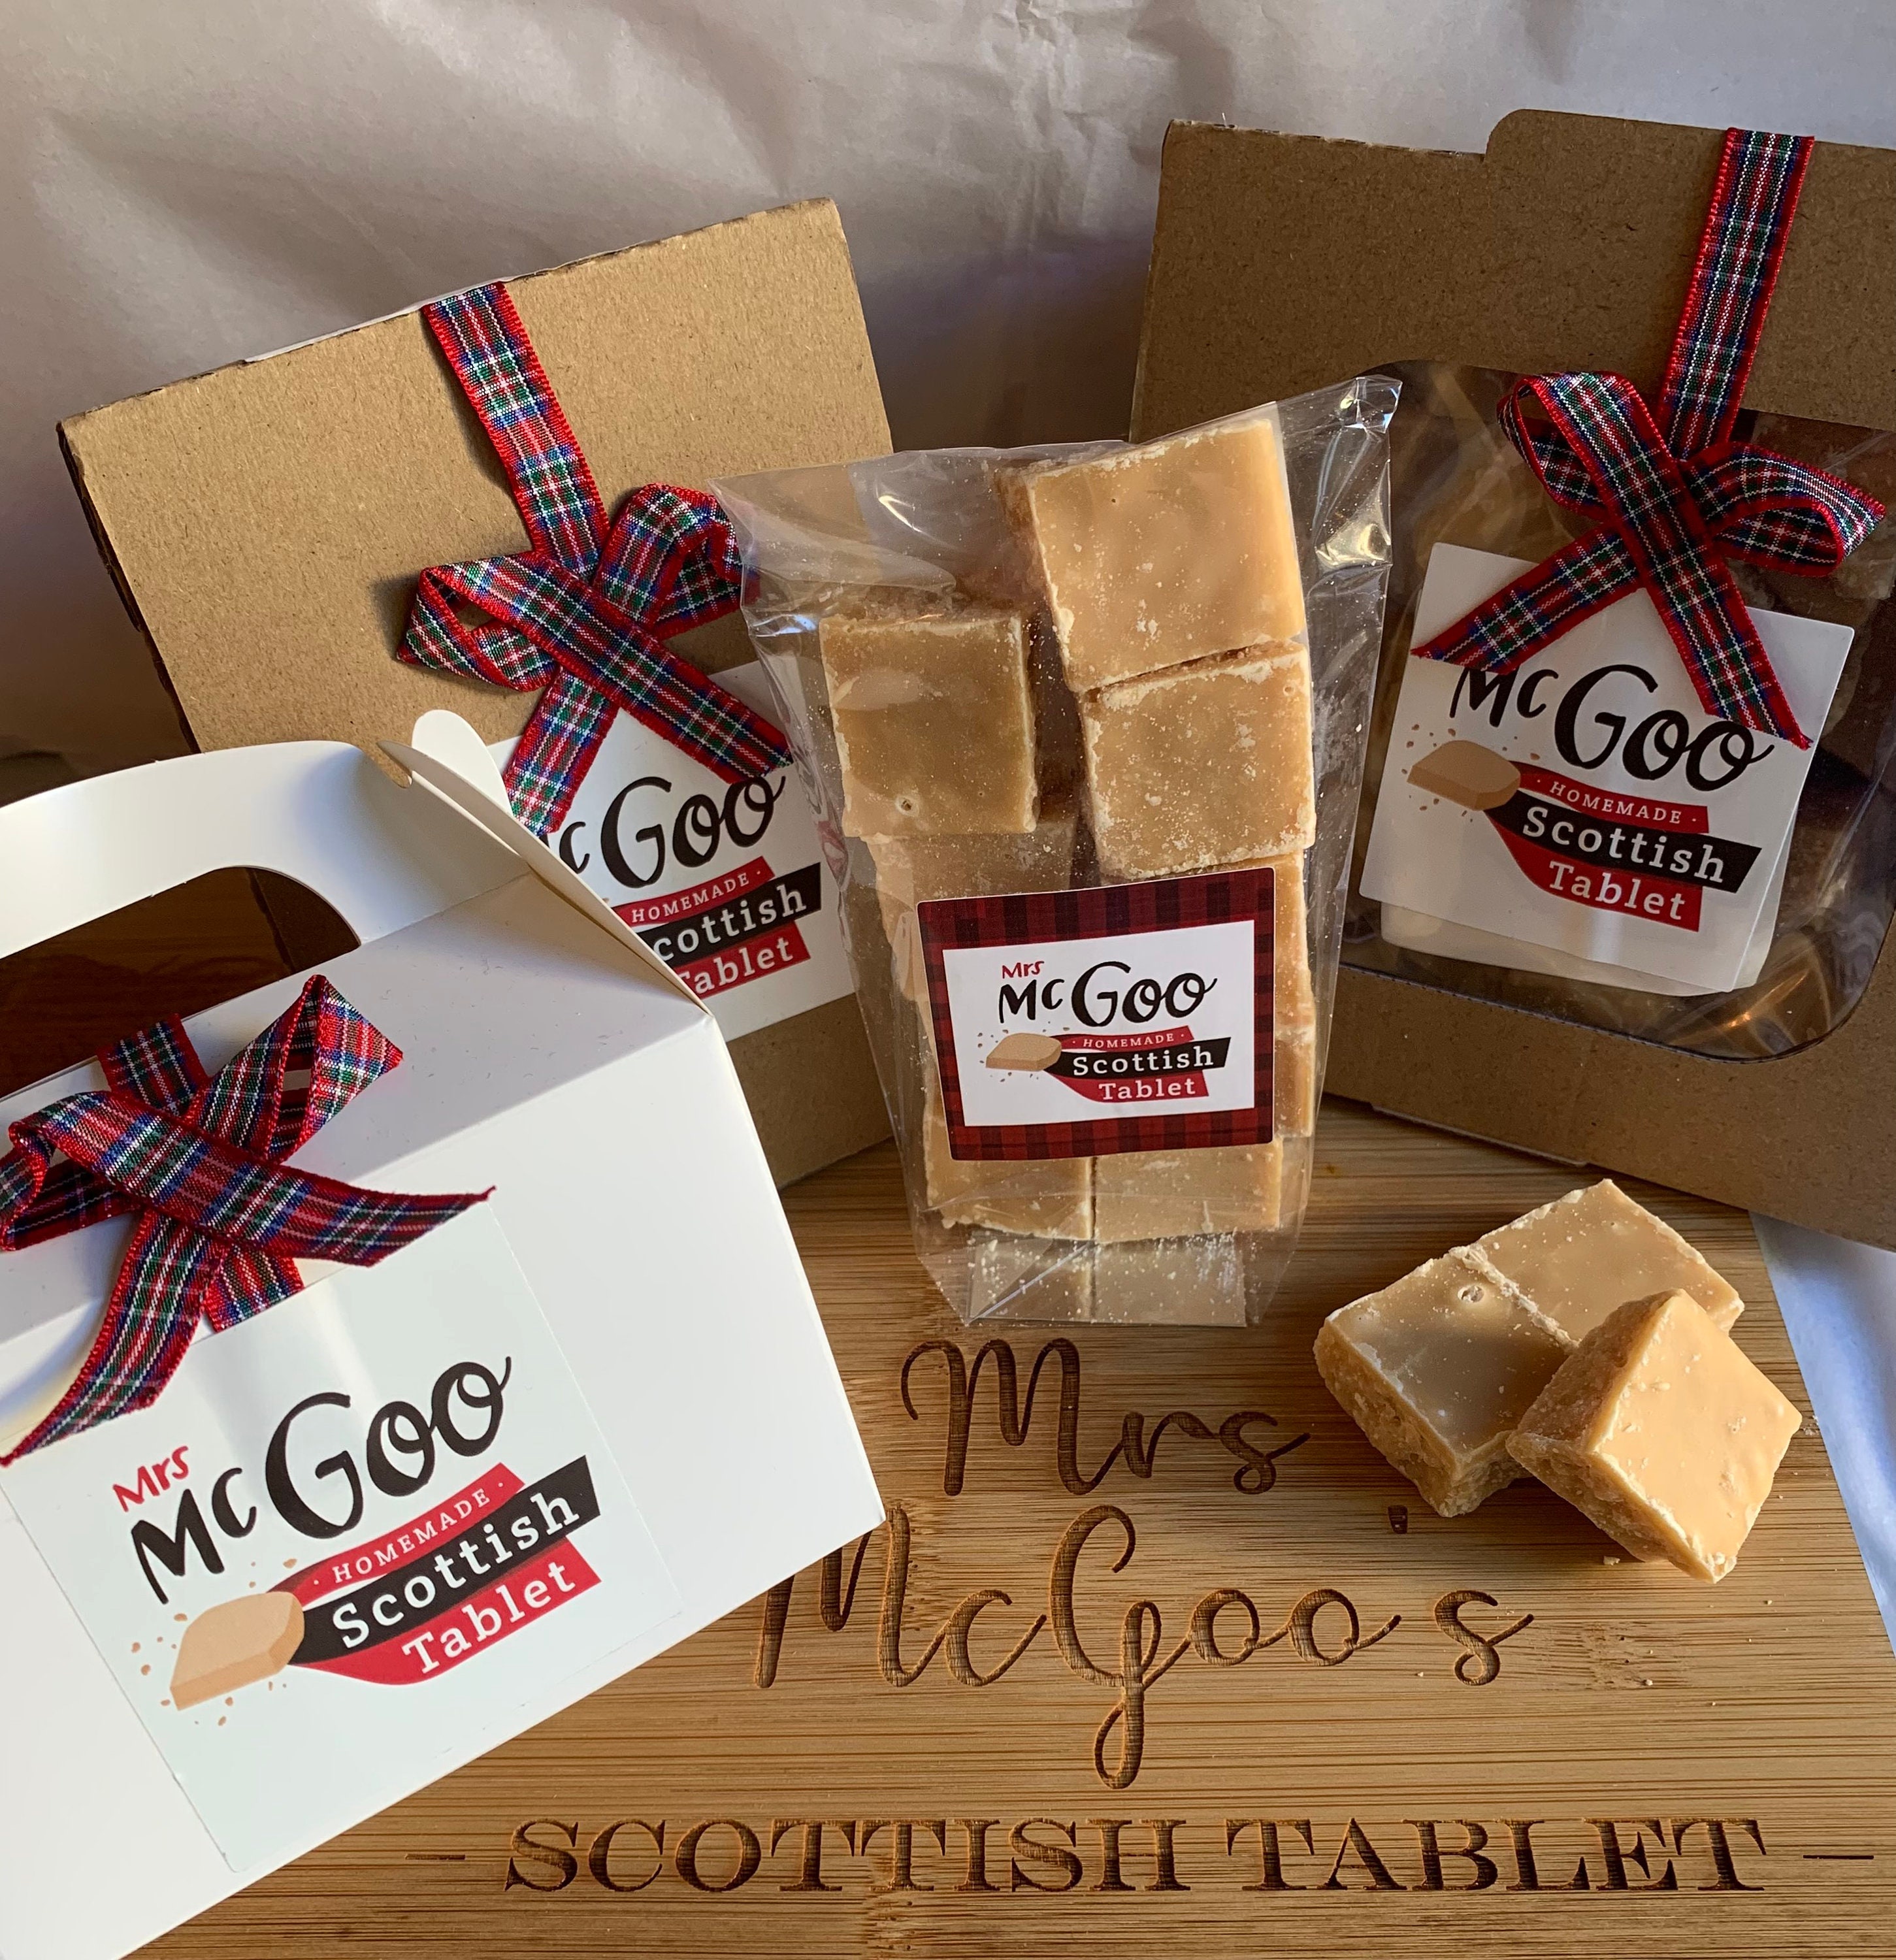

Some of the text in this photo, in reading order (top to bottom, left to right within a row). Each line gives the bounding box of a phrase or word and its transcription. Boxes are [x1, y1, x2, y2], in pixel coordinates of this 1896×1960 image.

[536, 775, 787, 889] cGoo
[1548, 781, 1682, 825] HOMEMADE
[1521, 806, 1725, 883] Scottish
[630, 871, 751, 923] HOMEMADE
[653, 884, 808, 962] cottish
[1547, 860, 1687, 920] Tablet
[1001, 960, 1045, 979] Mrs
[1073, 1046, 1215, 1076] Scottish
[1083, 1032, 1174, 1049] HOMEMADE
[1098, 1077, 1196, 1102] Tablet
[901, 1337, 1310, 1496] Mrs
[112, 1445, 190, 1513] Mrs
[331, 1494, 580, 1649] Scottish
[332, 1487, 491, 1584] HOMEMADE
[401, 1559, 576, 1674] Tablet
[504, 1816, 1767, 1893] SCOTTISH TABLET
